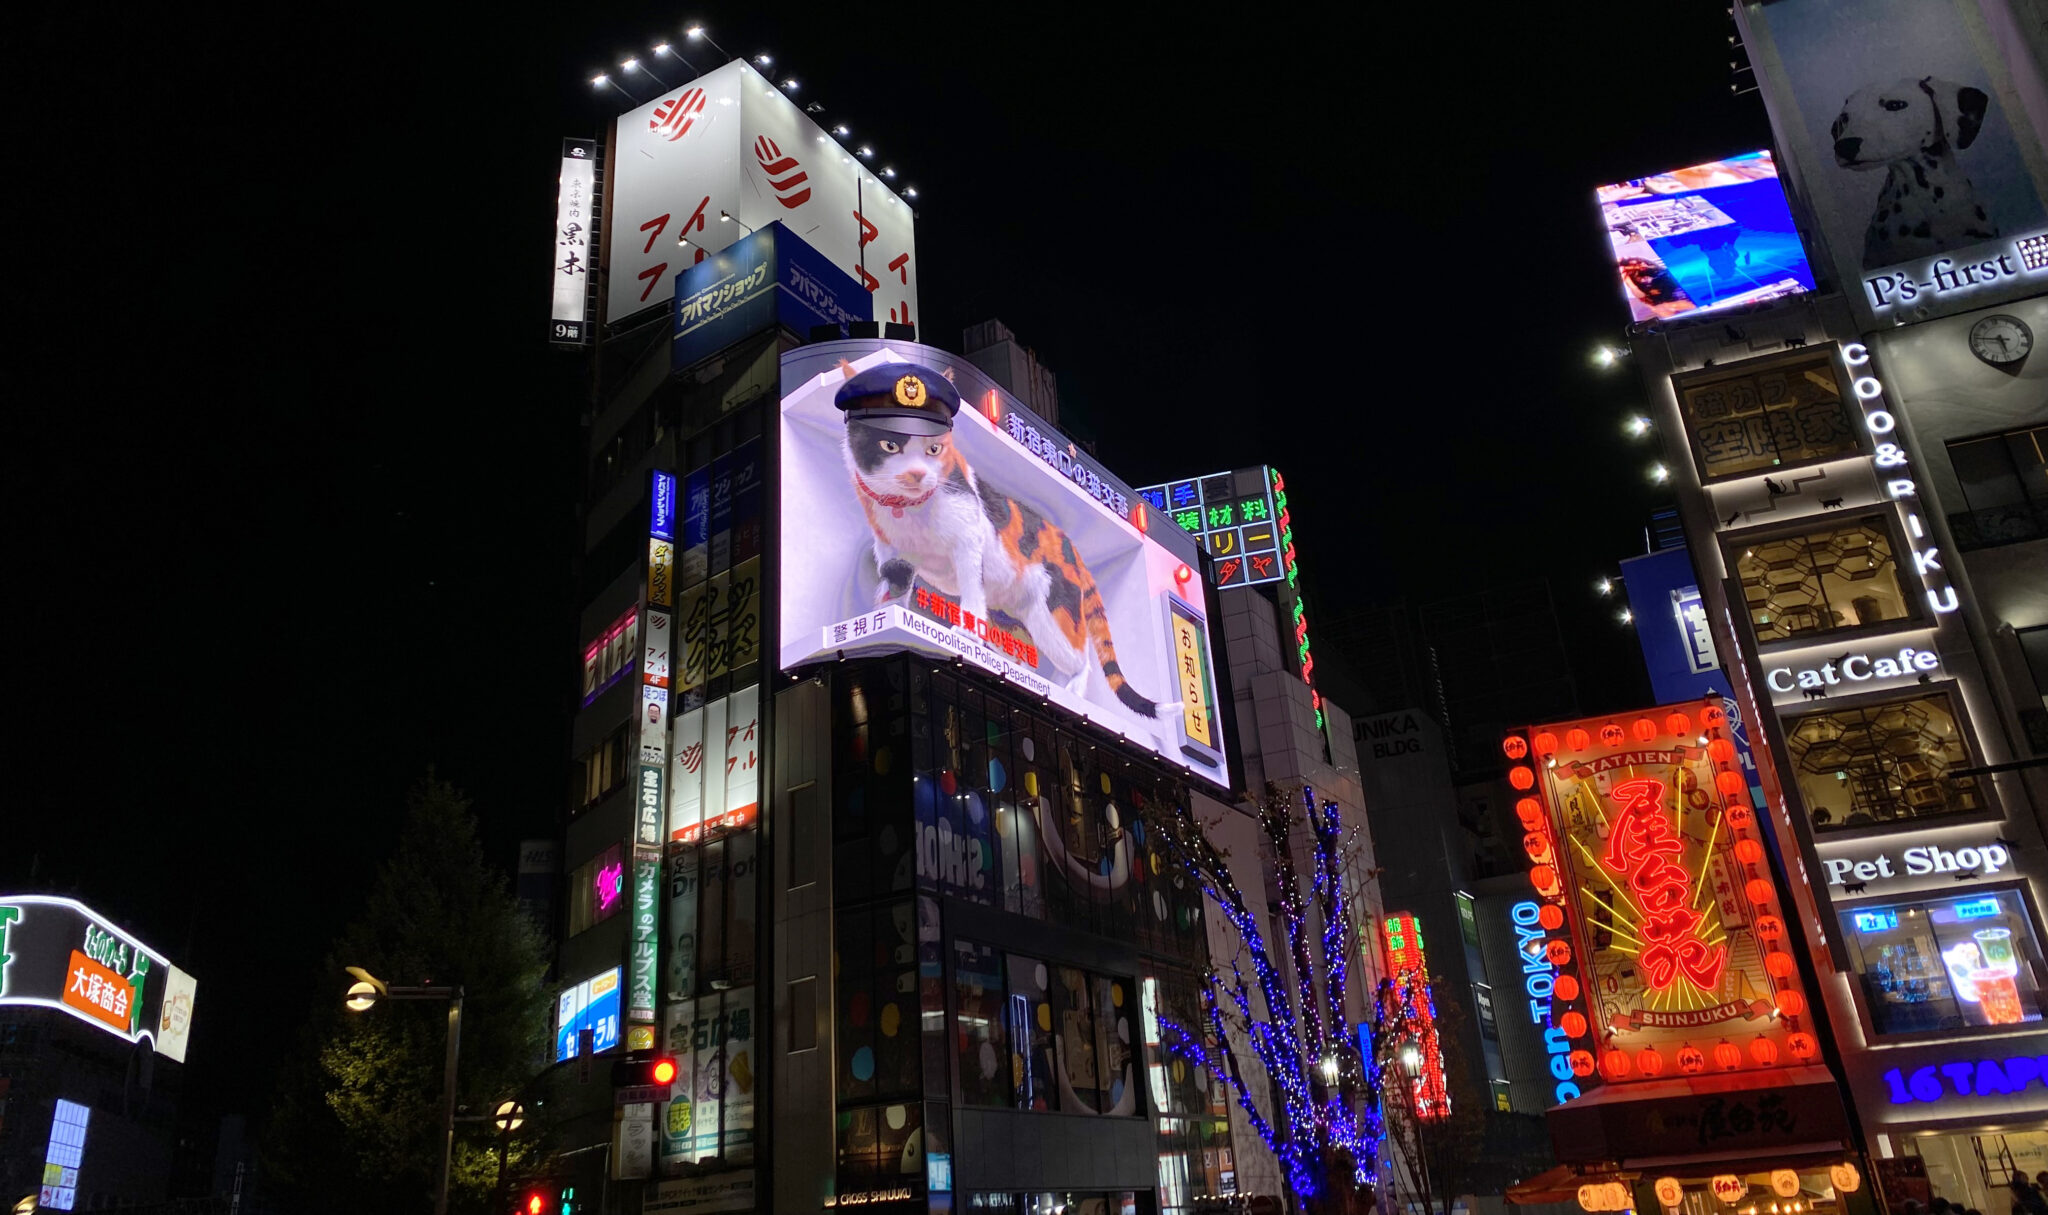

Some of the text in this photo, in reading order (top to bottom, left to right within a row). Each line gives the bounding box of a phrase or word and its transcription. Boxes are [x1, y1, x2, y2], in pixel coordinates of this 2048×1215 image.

[557, 222, 585, 276] 黒木
[681, 262, 767, 325] アパマンショップ
[1866, 254, 2017, 308] P's-first
[1006, 412, 1128, 519] 新宿東口の猫交番
[1842, 343, 1960, 613] COO&RIKU
[834, 611, 887, 643] 警視庁
[916, 587, 1039, 668] #新宿東口の猫交番
[649, 675, 661, 685] 4F
[902, 612, 1051, 697] Metropolitan Police Department
[1181, 627, 1202, 734] お知らせ
[1587, 752, 1671, 773] YATAIEN
[641, 770, 658, 843] 宝石広場
[672, 876, 696, 898] Dr
[1605, 780, 1724, 990] 屋台苑
[1823, 854, 1895, 885] Pet
[1904, 845, 2007, 876] Shop
[633, 863, 656, 1008] カメラのアルプス堂
[1512, 901, 1554, 1024] TOKYO
[71, 967, 128, 1018] 大塚商会
[561, 995, 571, 1014] 3F
[1643, 1005, 1738, 1026] SHINJUKU
[566, 1014, 616, 1058] セラル
[670, 1008, 750, 1054] 宝石広場
[840, 1187, 912, 1205] CROSS SHINJUKU
